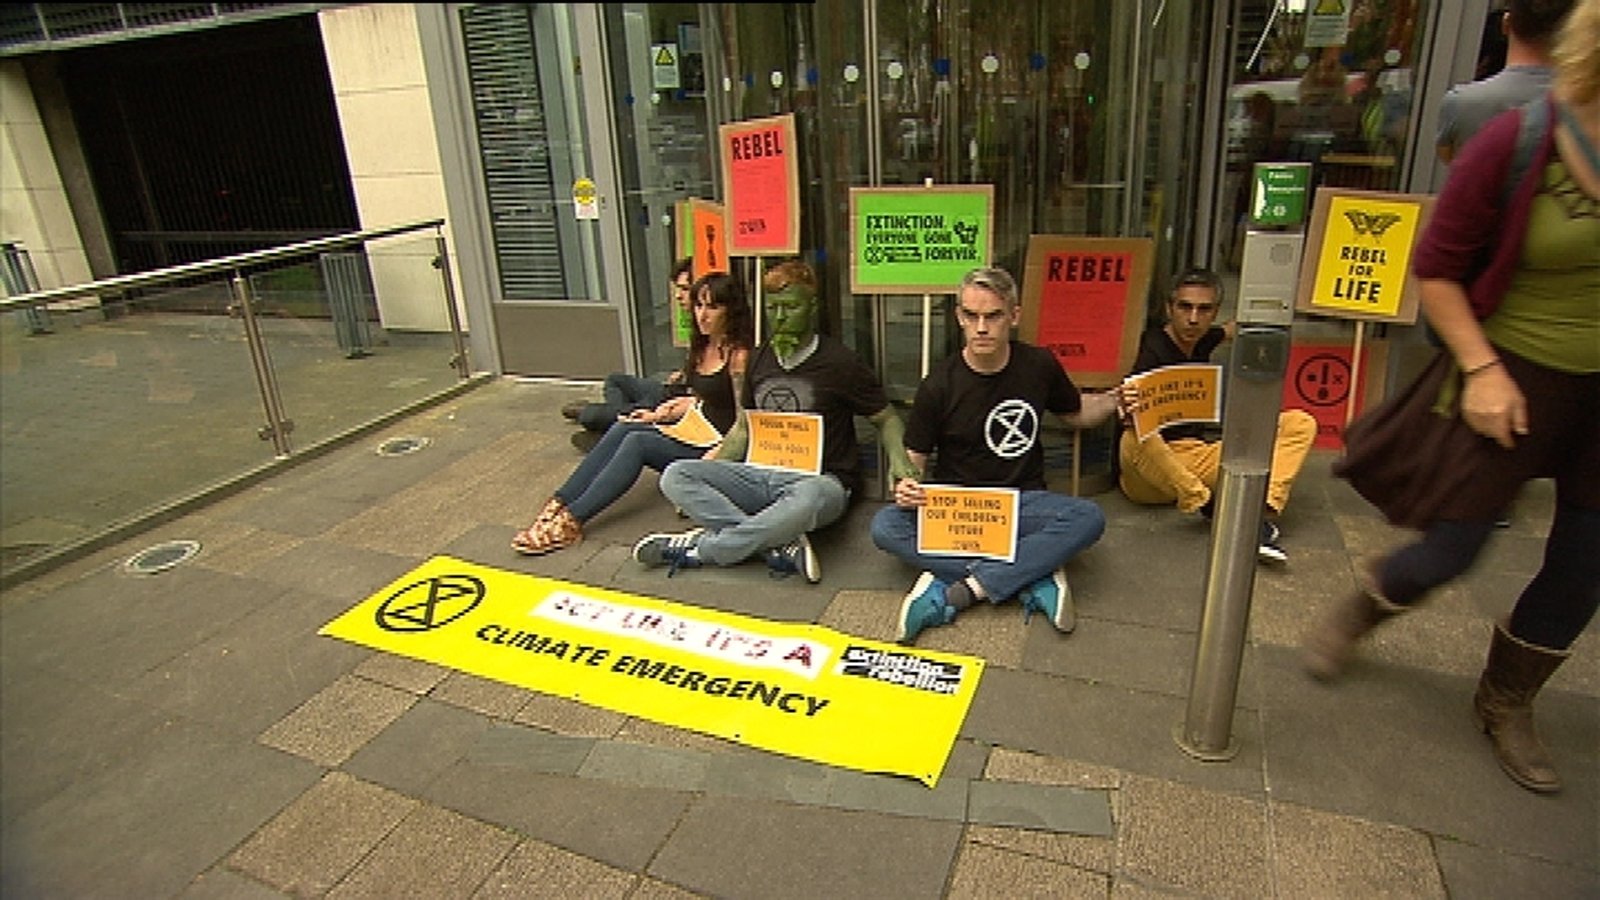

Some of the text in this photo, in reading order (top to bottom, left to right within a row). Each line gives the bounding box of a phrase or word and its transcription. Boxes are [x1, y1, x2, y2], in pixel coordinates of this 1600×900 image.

[732, 131, 783, 160] REBEL
[866, 231, 952, 244] EVERYONE GONE
[1340, 247, 1387, 266] REBEL
[1047, 256, 1125, 282] REBEL
[1348, 265, 1374, 278] FOR
[1333, 278, 1381, 304] LIFE
[932, 495, 1001, 510] STOP SELLING
[926, 508, 946, 520] OUR
[948, 524, 983, 536] FUTURE
[783, 643, 813, 669] A
[475, 624, 831, 717] CLIMATE EMERGENCY
[867, 667, 959, 695] rebellion
